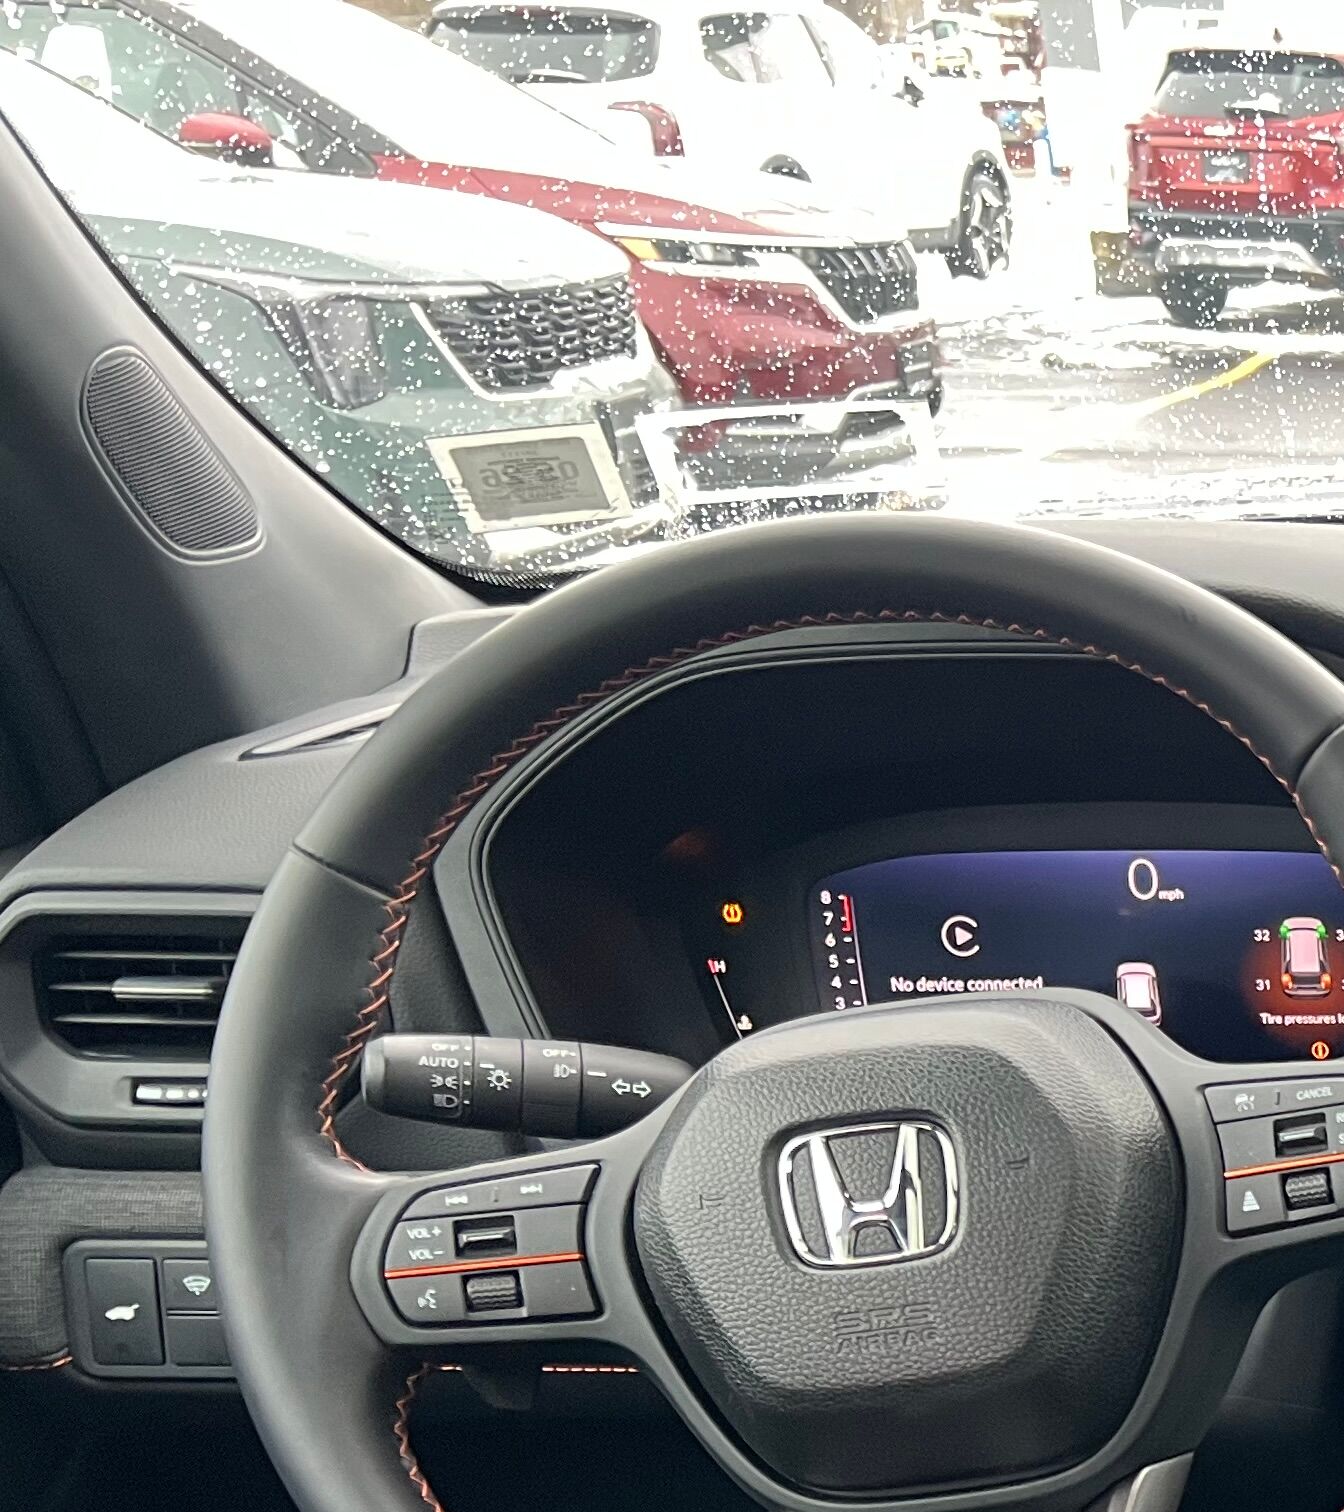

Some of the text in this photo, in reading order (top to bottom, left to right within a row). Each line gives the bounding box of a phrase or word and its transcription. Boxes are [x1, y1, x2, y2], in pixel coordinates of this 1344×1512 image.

[1128, 858, 1185, 901] 0 mph
[820, 890, 832, 905] 8
[822, 911, 834, 926] 7
[825, 933, 837, 948] 6
[1253, 929, 1271, 942] 32
[828, 954, 839, 969] 5
[831, 975, 842, 989] 4
[890, 976, 1043, 993] No device connected
[1255, 979, 1271, 991] 31
[835, 996, 846, 1010] 3
[1259, 1012, 1283, 1024] Tire
[1284, 1013, 1336, 1026] pressures
[418, 1056, 459, 1069] AUTO
[1296, 1086, 1333, 1100] CANCEL
[834, 1302, 936, 1331] SRS
